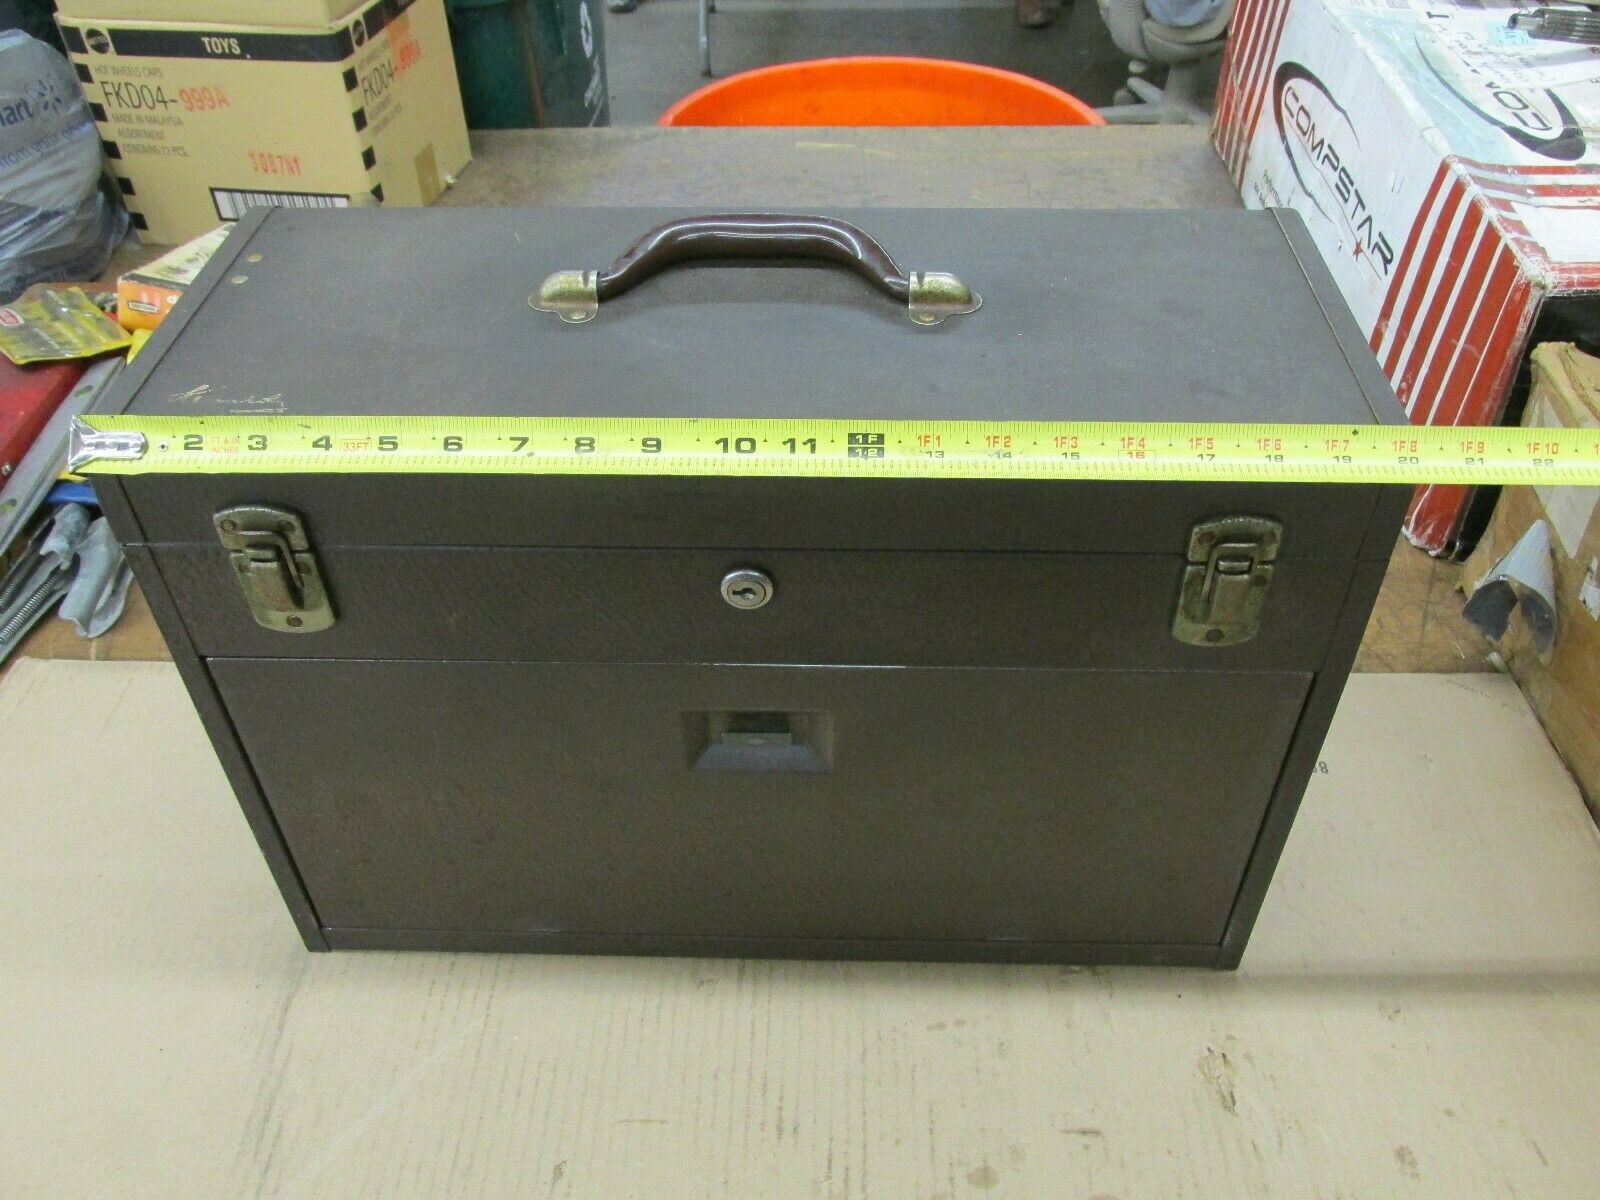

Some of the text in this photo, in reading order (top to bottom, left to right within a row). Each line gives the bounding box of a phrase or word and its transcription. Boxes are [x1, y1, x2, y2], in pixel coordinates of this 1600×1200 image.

[200, 36, 242, 55] TOYS
[1284, 86, 1394, 276] COMPSTAR
[183, 434, 817, 455] 2 3 4 5 6 7 8 9 10 11
[343, 442, 371, 453] 33FT
